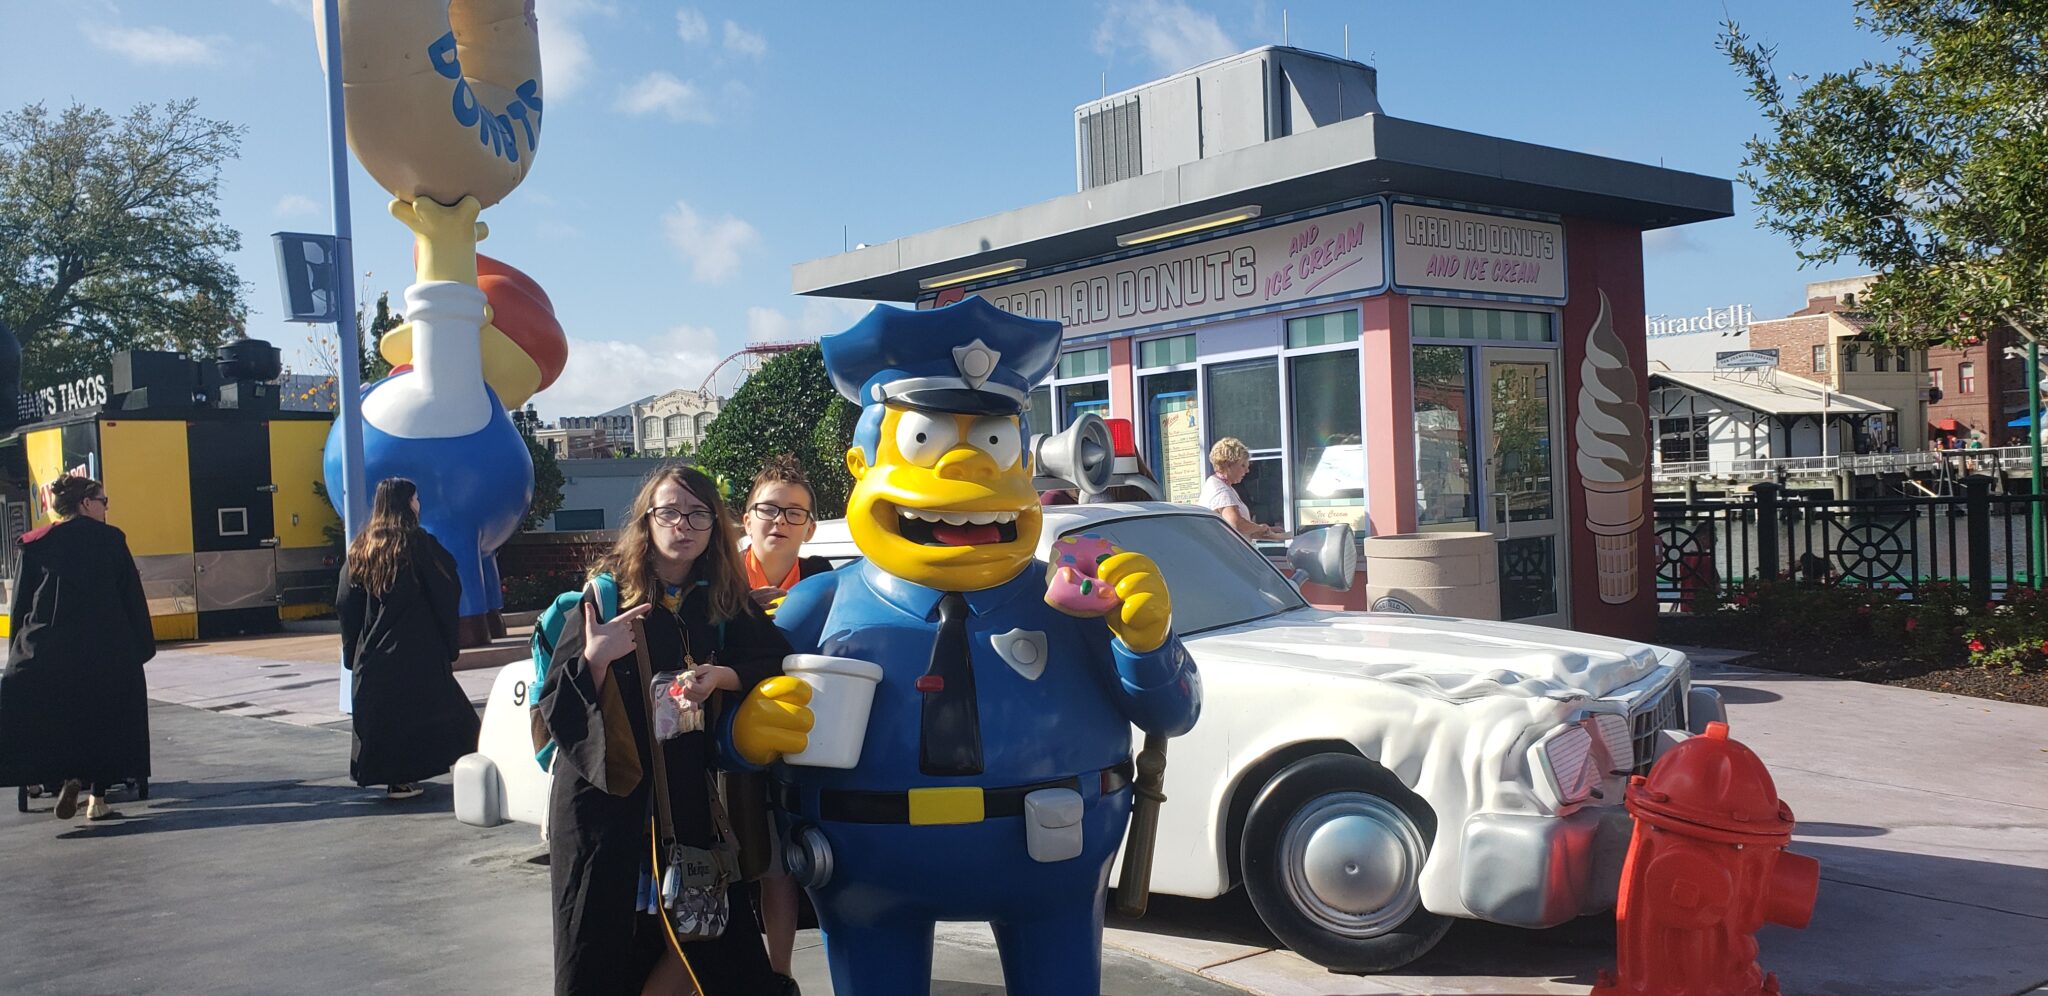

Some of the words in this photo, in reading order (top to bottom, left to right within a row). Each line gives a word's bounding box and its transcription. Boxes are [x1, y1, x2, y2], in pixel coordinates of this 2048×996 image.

[1289, 223, 1319, 257] AND
[1404, 213, 1451, 248] LARD
[1455, 220, 1487, 252] LAD
[1490, 224, 1554, 260] DONUTS
[1264, 262, 1294, 300] ICE
[1299, 221, 1365, 280] CREAM
[1426, 253, 1460, 278] AND
[1463, 256, 1489, 281] ICE
[1491, 258, 1541, 284] CREAM
[1054, 275, 1110, 328] LAD
[1116, 245, 1257, 319] DONUTS
[1645, 303, 1752, 336] hirardelli
[58, 374, 107, 412] TACOS
